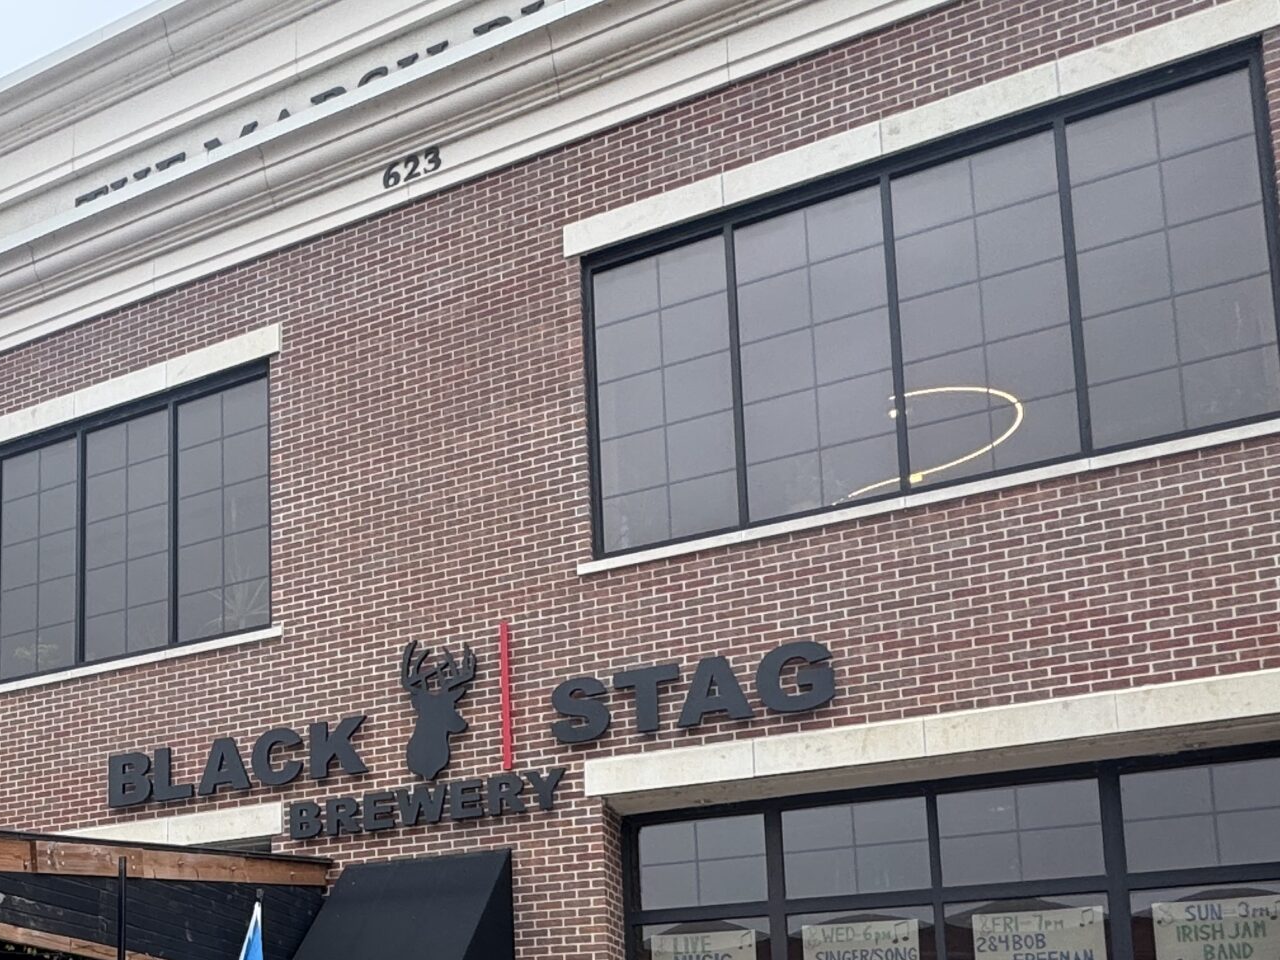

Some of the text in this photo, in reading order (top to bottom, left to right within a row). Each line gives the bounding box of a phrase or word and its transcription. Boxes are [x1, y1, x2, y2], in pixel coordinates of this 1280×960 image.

[383, 146, 441, 189] 623
[108, 641, 837, 808] BLACK STAG
[289, 767, 566, 840] BREWERY
[1013, 933, 1047, 951] BOB
[1176, 920, 1267, 942] IRISH JAM
[673, 935, 712, 954] LIVE
[1203, 942, 1254, 960] BAND
